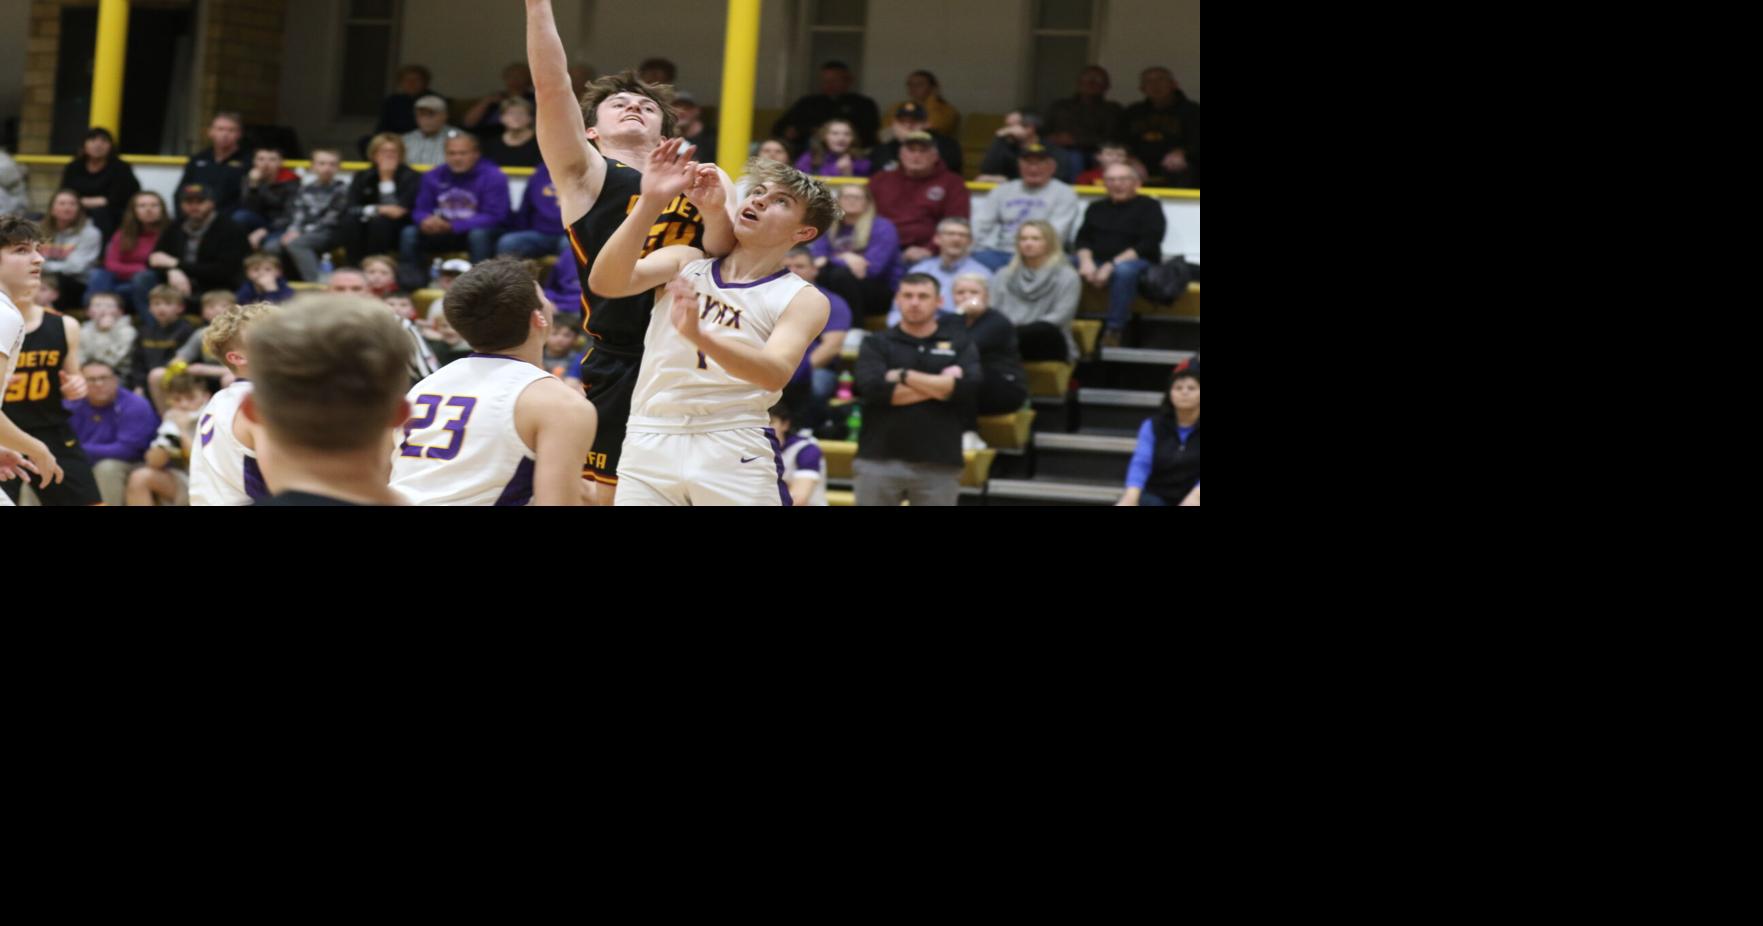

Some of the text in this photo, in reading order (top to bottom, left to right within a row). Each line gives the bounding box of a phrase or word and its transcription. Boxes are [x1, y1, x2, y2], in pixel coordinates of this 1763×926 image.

[695, 291, 742, 330] YNX
[16, 350, 60, 369] DETS
[4, 370, 50, 402] 30
[399, 393, 478, 462] 23
[586, 451, 607, 469] FA
